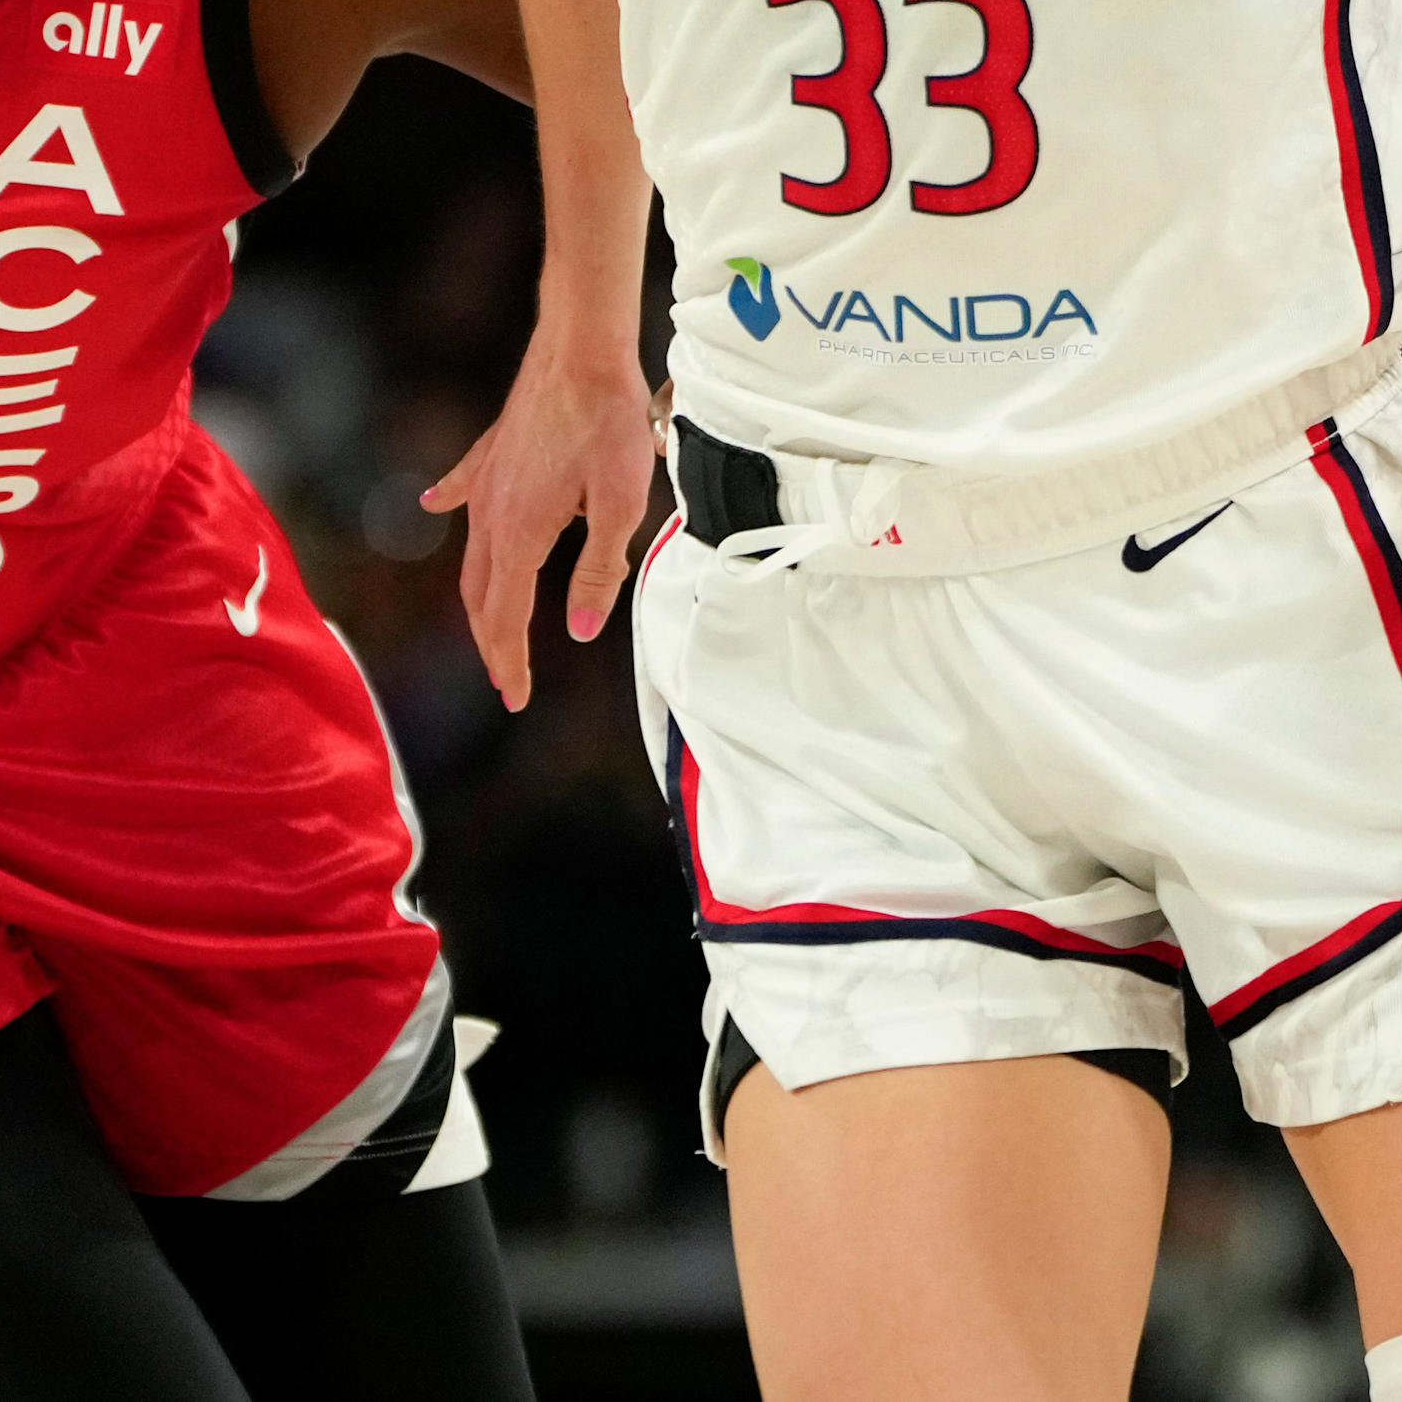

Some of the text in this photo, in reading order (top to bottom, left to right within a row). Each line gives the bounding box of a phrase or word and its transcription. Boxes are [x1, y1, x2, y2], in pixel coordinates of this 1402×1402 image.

[42, 2, 162, 75] ally
[784, 289, 1098, 343] VANDA
[819, 339, 1055, 364] PHARMACEUTICALS
